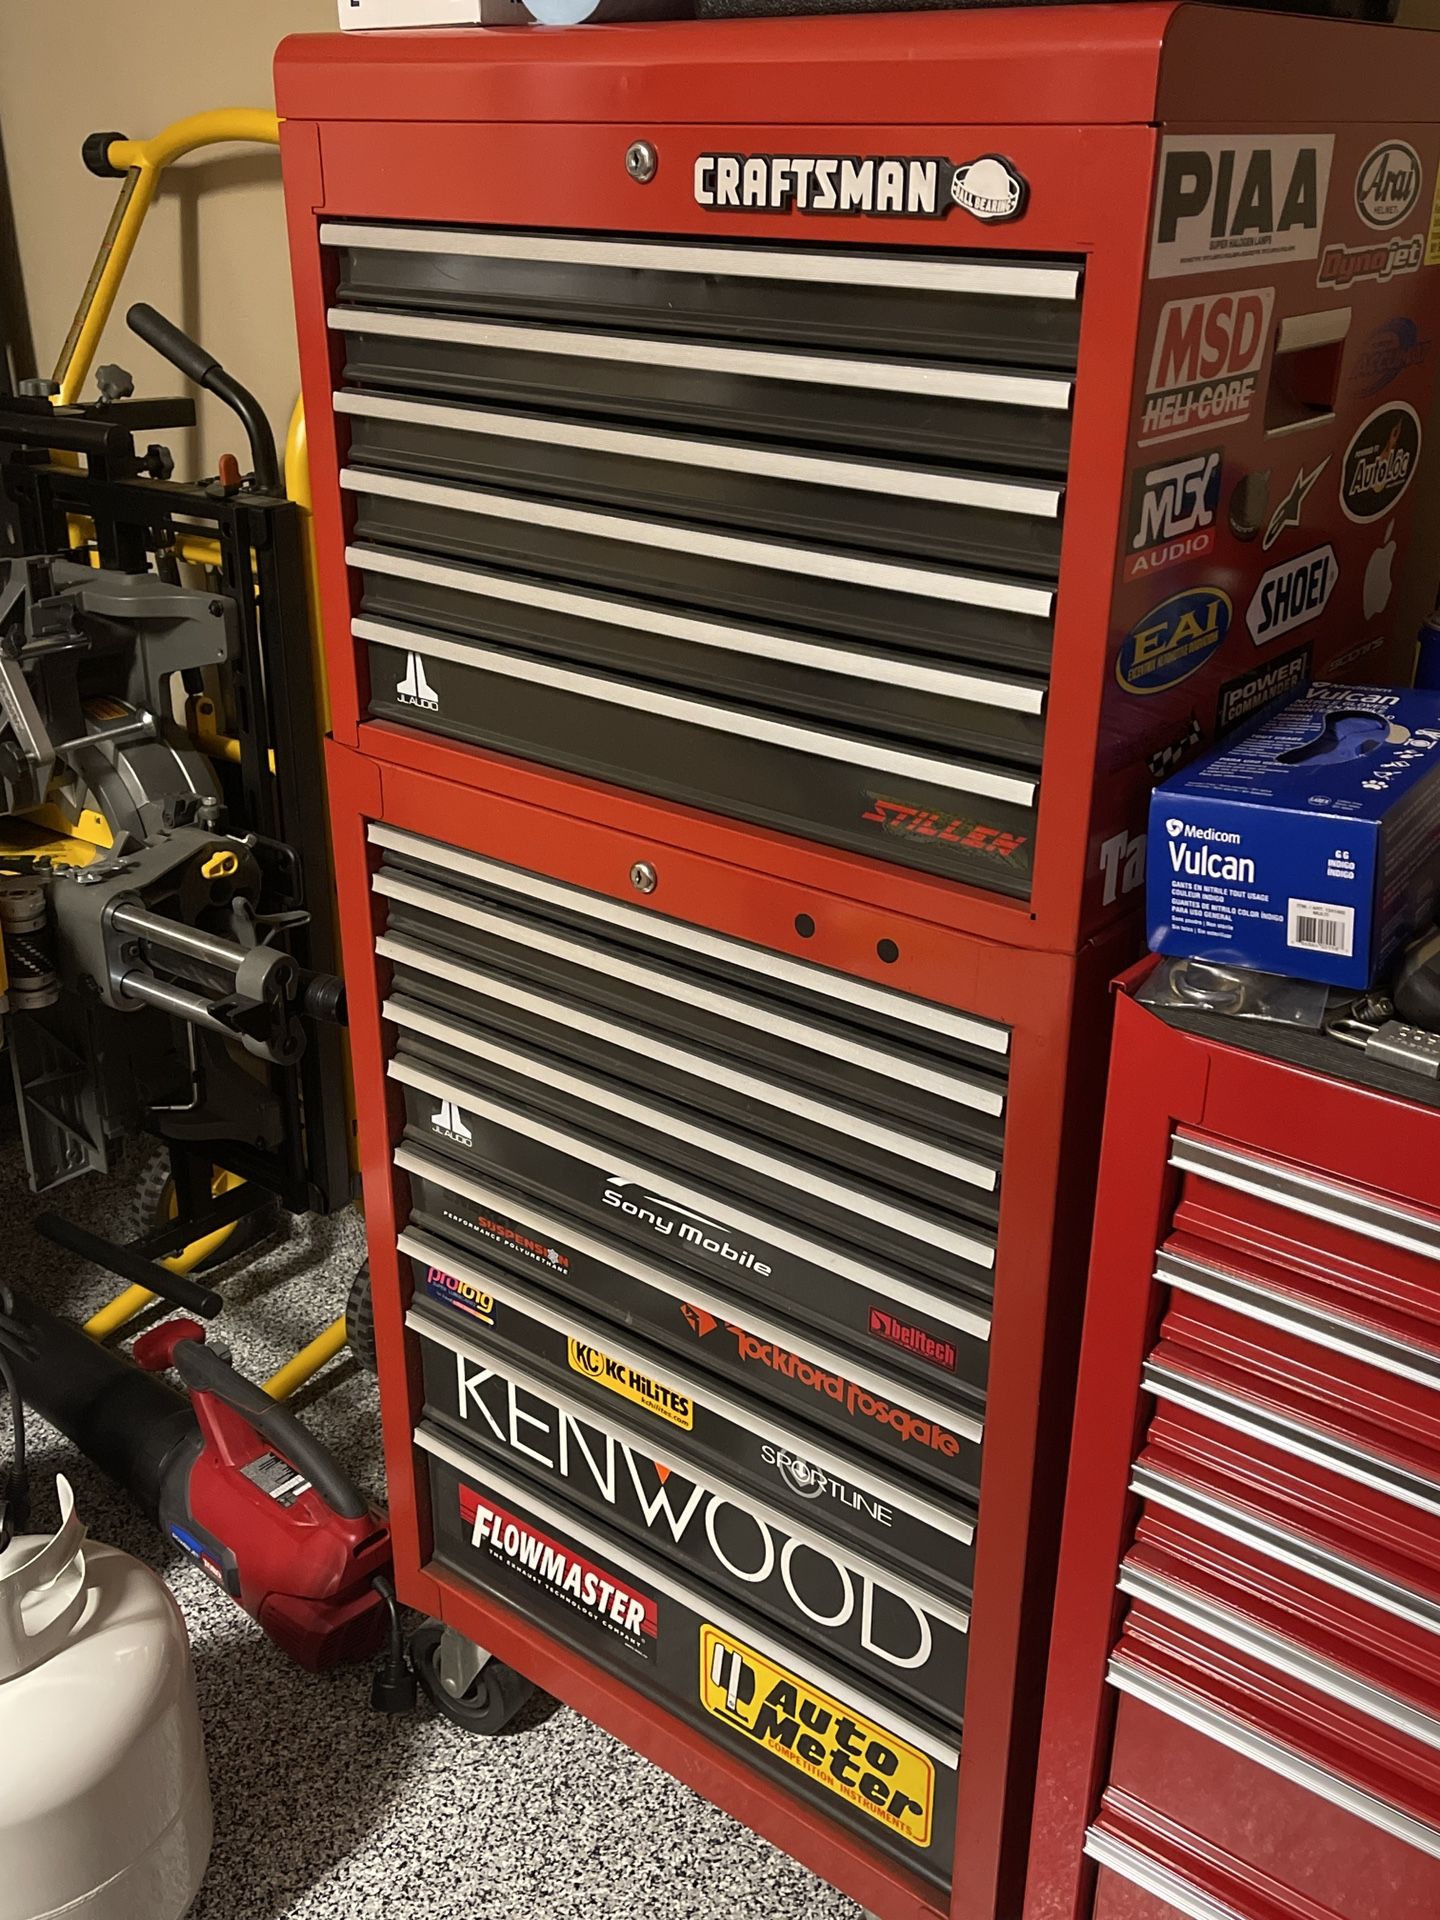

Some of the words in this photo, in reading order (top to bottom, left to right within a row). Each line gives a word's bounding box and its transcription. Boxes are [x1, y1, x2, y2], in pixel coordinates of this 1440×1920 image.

[694, 157, 937, 213] CRAFTSMAN
[1158, 148, 1317, 243] PIAA
[1360, 153, 1414, 201] Arai
[1322, 239, 1421, 283] Dynojet
[1155, 295, 1263, 388] MSD
[1142, 377, 1255, 433] HELI-CORE
[1133, 453, 1220, 549] MTX
[1131, 535, 1209, 574] AUDIO
[1257, 556, 1331, 634] SHOEI
[1131, 600, 1220, 666] EAI
[1228, 674, 1298, 720] COMMANDER
[1229, 658, 1301, 706] POWER
[1305, 688, 1400, 705] Vulcan
[862, 800, 1028, 857] STILLEN
[1184, 824, 1241, 845] Medicom
[1168, 840, 1255, 884] Vulcan
[1171, 880, 1193, 890] GANTS
[1203, 886, 1228, 896] NITRILE
[1229, 889, 1246, 898] TOUT
[1171, 906, 1189, 914] PARA
[443, 1210, 501, 1242] PERFORMANCE
[504, 1240, 568, 1275] POLYURETHANE
[602, 1189, 674, 1235] Sony
[678, 1223, 772, 1277] Mobile
[576, 1341, 600, 1373] KC
[605, 1357, 626, 1385] KC
[641, 1396, 689, 1427] kchilites.com
[456, 1353, 932, 1669] KENWOOD
[760, 1445, 893, 1527] SPORTLINE
[471, 1504, 645, 1636] FLOWMASTER
[489, 1549, 503, 1561] THE
[506, 1560, 541, 1584] EXHAUST
[545, 1583, 598, 1620] TECHNOLOGY
[602, 1619, 641, 1647] COMPANY
[765, 1680, 899, 1776] Auto
[751, 1702, 924, 1819] Meter
[767, 1739, 835, 1786] COMPETITION
[839, 1783, 914, 1836] INSTRUMENTS
